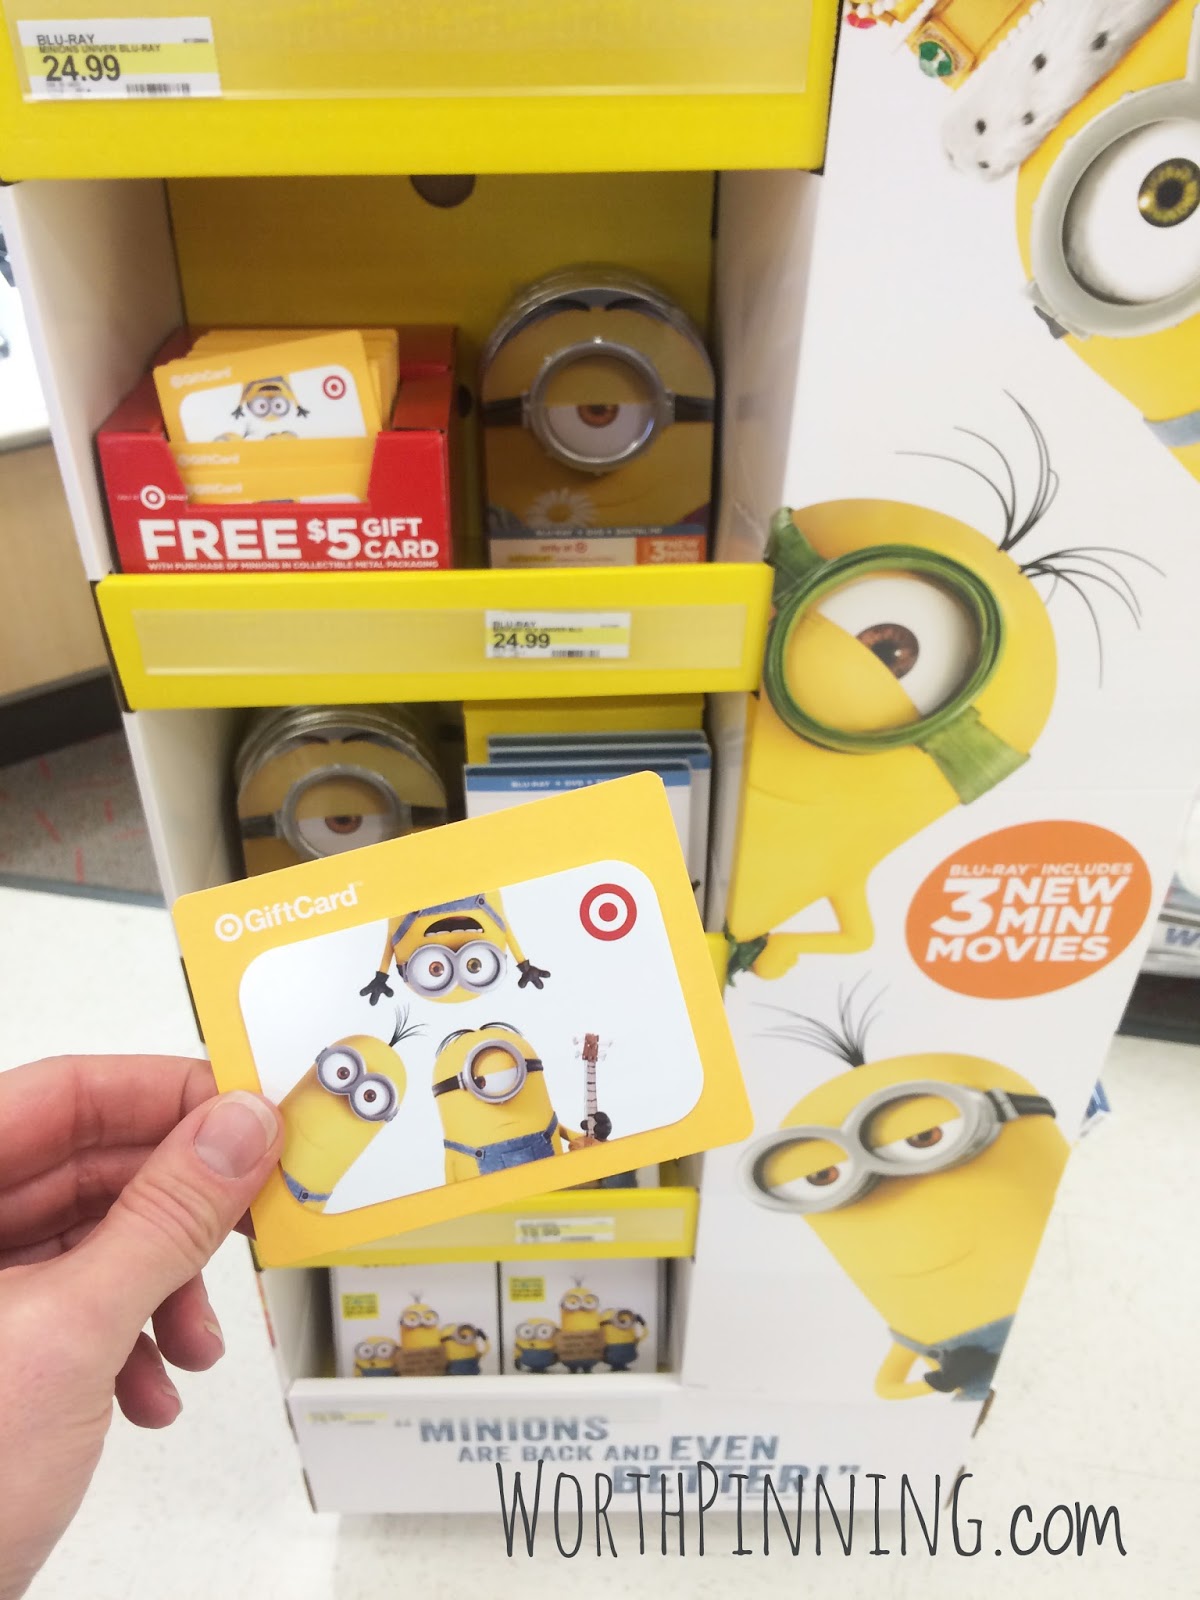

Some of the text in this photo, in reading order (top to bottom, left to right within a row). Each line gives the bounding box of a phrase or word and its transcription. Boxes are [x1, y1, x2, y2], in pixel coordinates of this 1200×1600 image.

[37, 34, 95, 46] BLU-RAY
[119, 44, 160, 52] BLU-RAY
[43, 55, 121, 81] 24.99
[362, 517, 423, 537] GIFT
[138, 518, 361, 561] FREE $5
[364, 539, 439, 559] CARD
[147, 560, 439, 570] WITH PURCHASE OF MINIONS IN COLLECTIBLE METAL PACKAGING
[493, 633, 551, 649] 24.99
[949, 862, 1134, 877] BLU-RAY INCLUDES
[244, 883, 359, 933] GiftCard
[930, 876, 1131, 936] 3 NEW
[996, 906, 1113, 934] MINI
[925, 935, 1111, 963] MOVIES
[458, 1435, 779, 1462] ARE BACK AND EVEN
